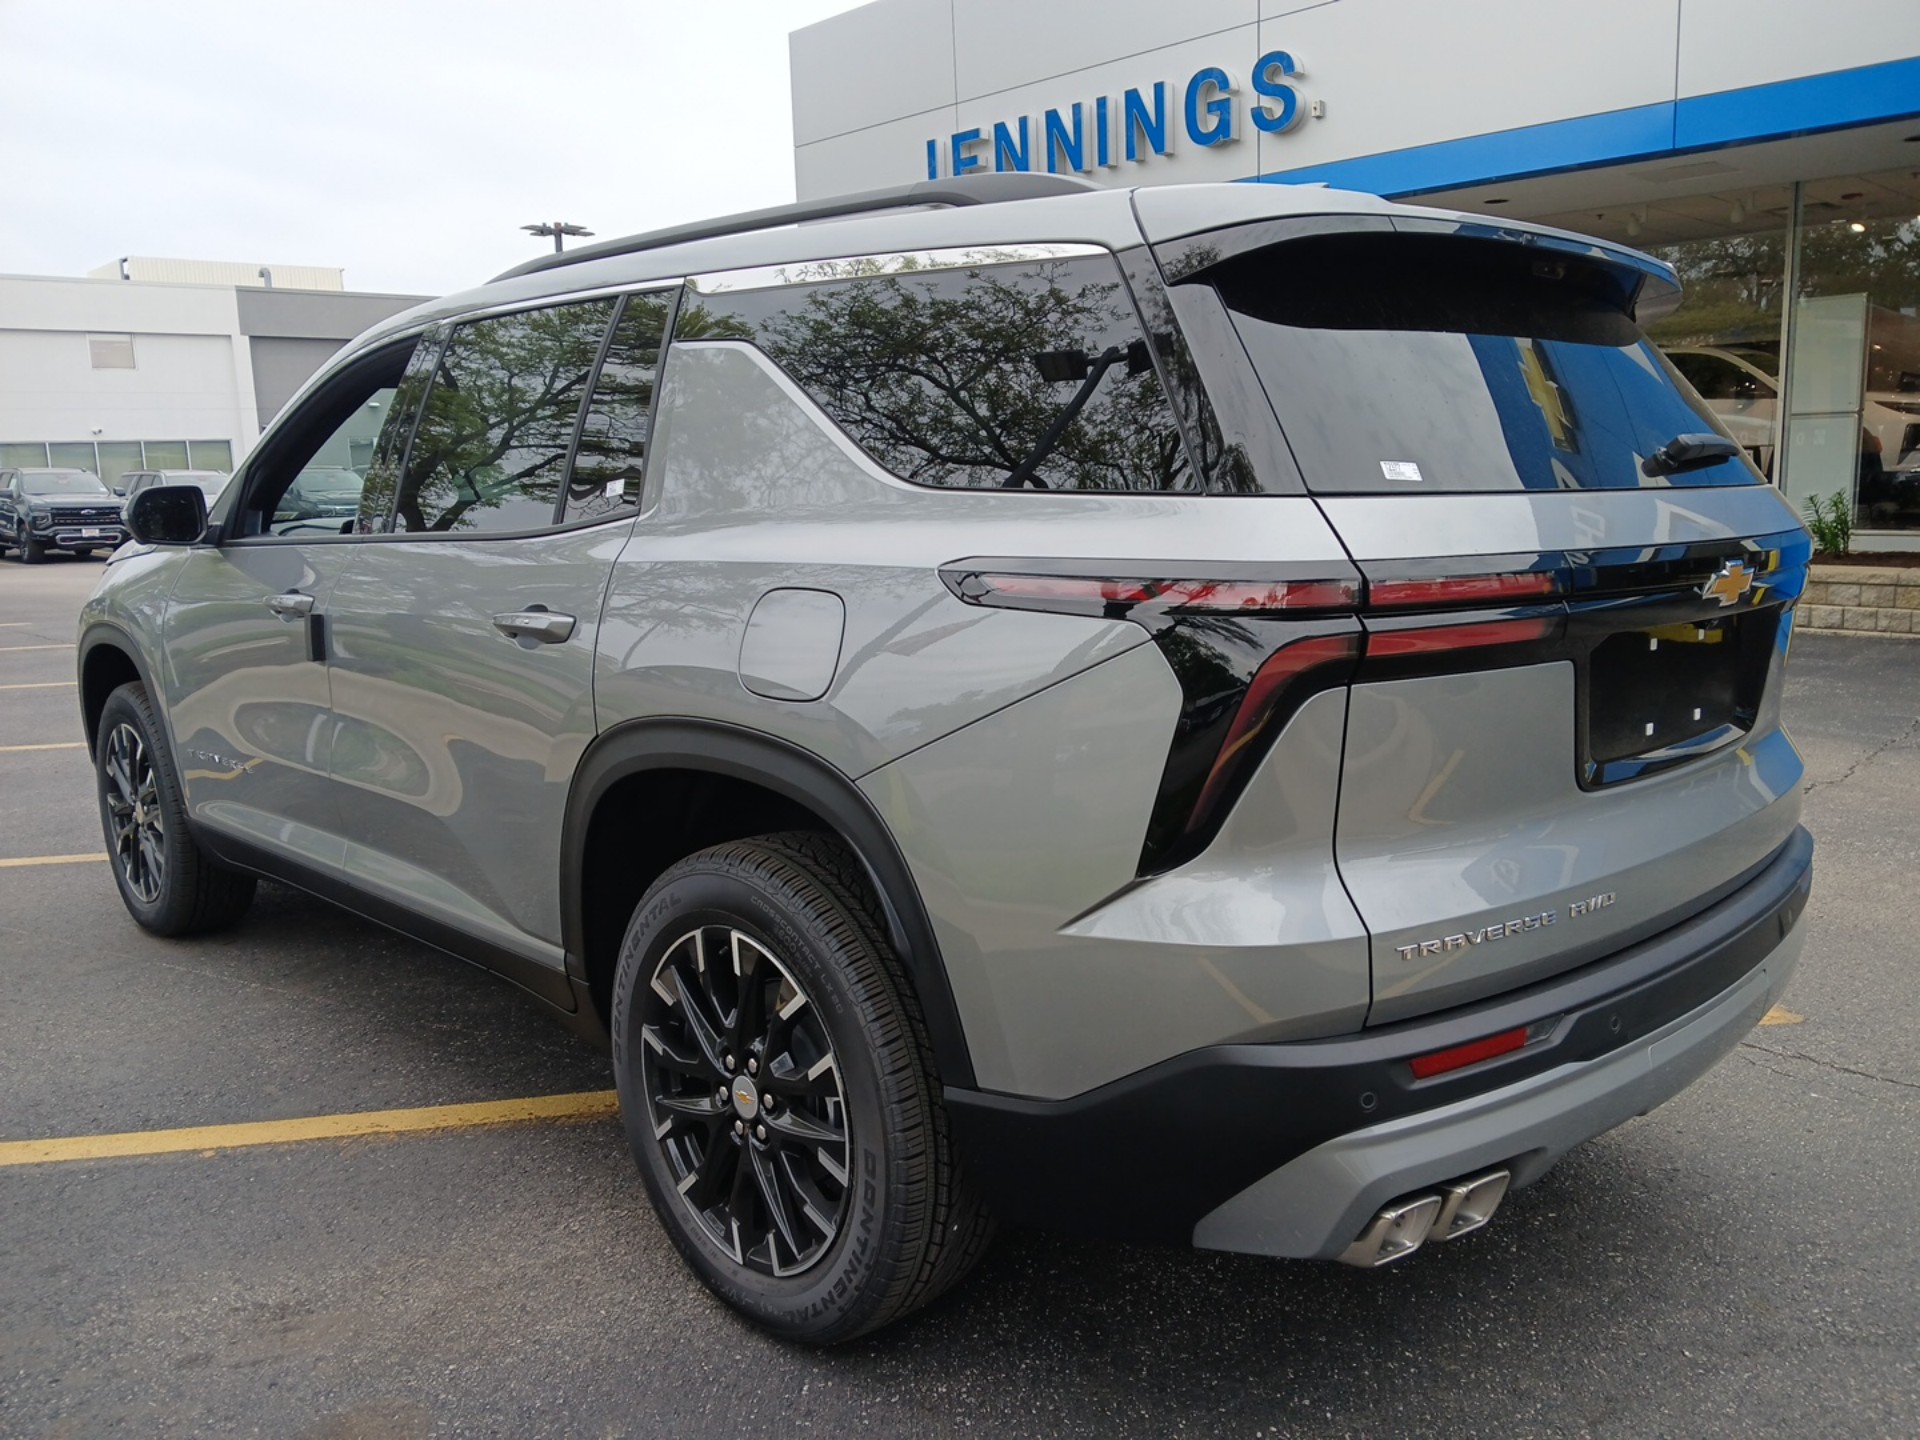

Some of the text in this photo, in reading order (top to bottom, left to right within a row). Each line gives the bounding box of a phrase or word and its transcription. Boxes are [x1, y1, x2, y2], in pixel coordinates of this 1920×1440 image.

[613, 892, 682, 1065] CONTINENTAL
[750, 896, 821, 970] CROSSCONTACT
[1395, 891, 1617, 961] TRAVERSE AWD
[783, 1147, 877, 1322] CONTINENTAL
